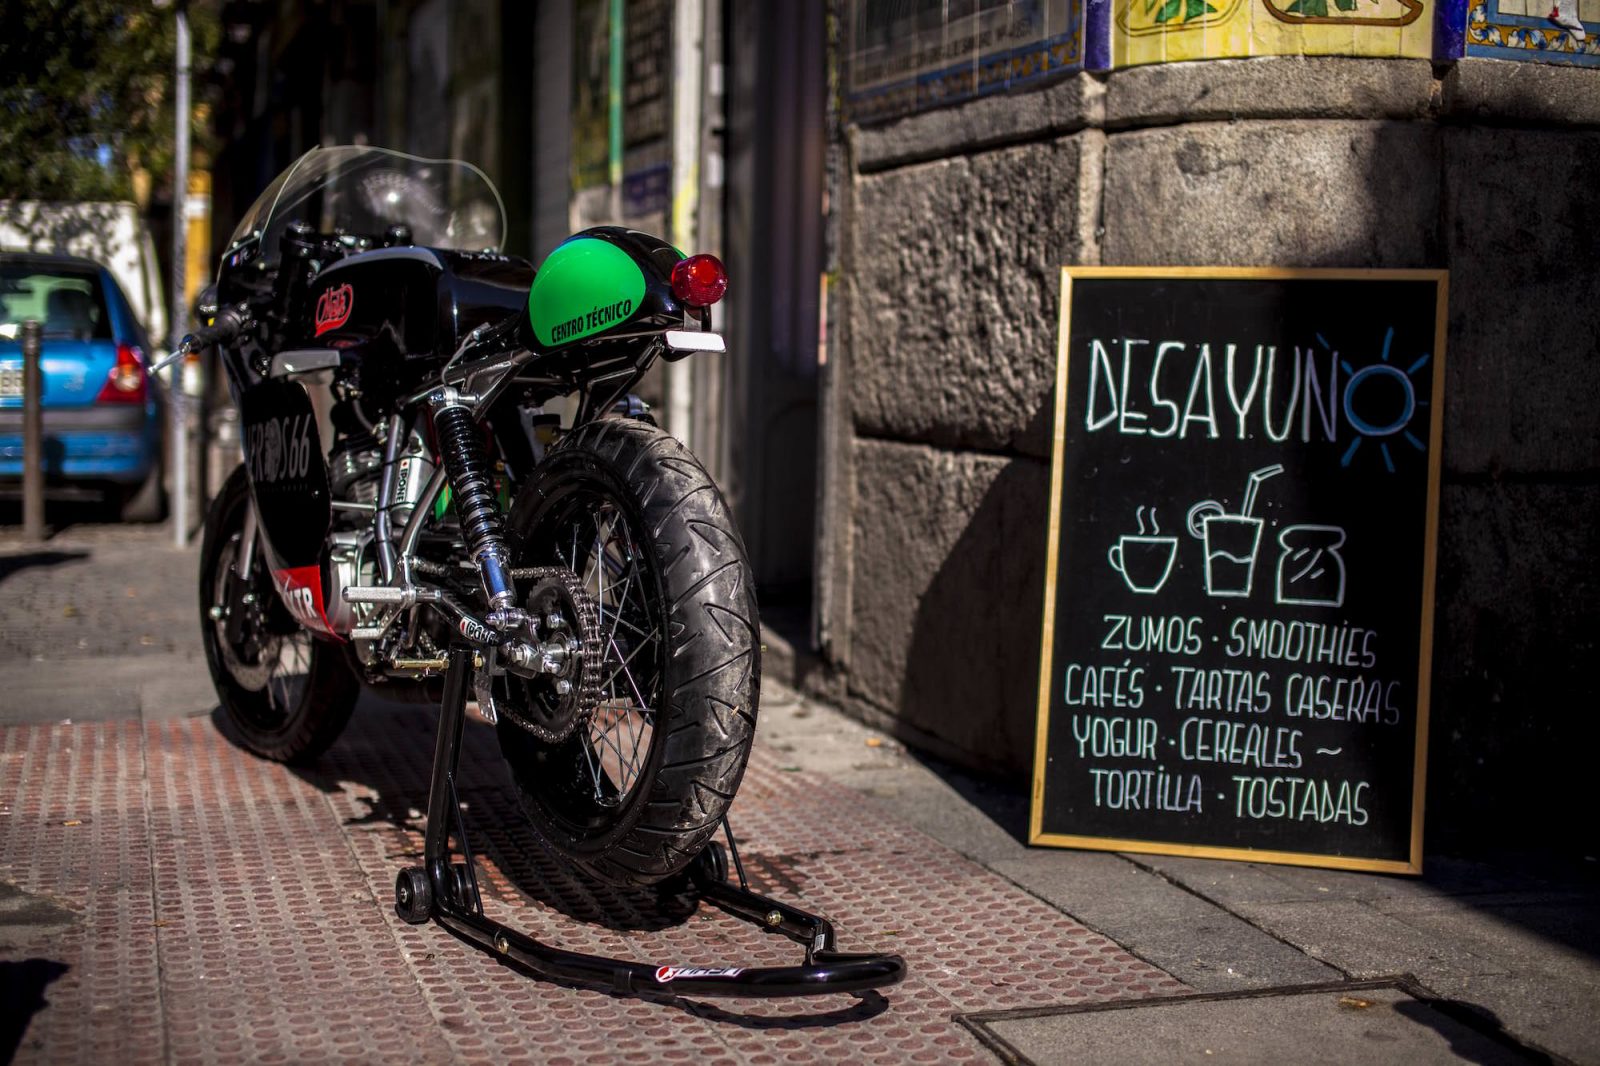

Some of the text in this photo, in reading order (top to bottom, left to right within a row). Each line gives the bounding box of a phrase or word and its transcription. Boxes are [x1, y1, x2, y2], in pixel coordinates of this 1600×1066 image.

[551, 299, 632, 344] CENTRO TÉCNICO
[1100, 614, 1378, 668] ZUMOS SMOOTHIES
[1064, 659, 1401, 725] CAFÉS TARTAS CASERAS
[1072, 714, 1303, 769] YOGUR CEREALES
[1089, 765, 1370, 825] TORTILLA TOSTADAS
